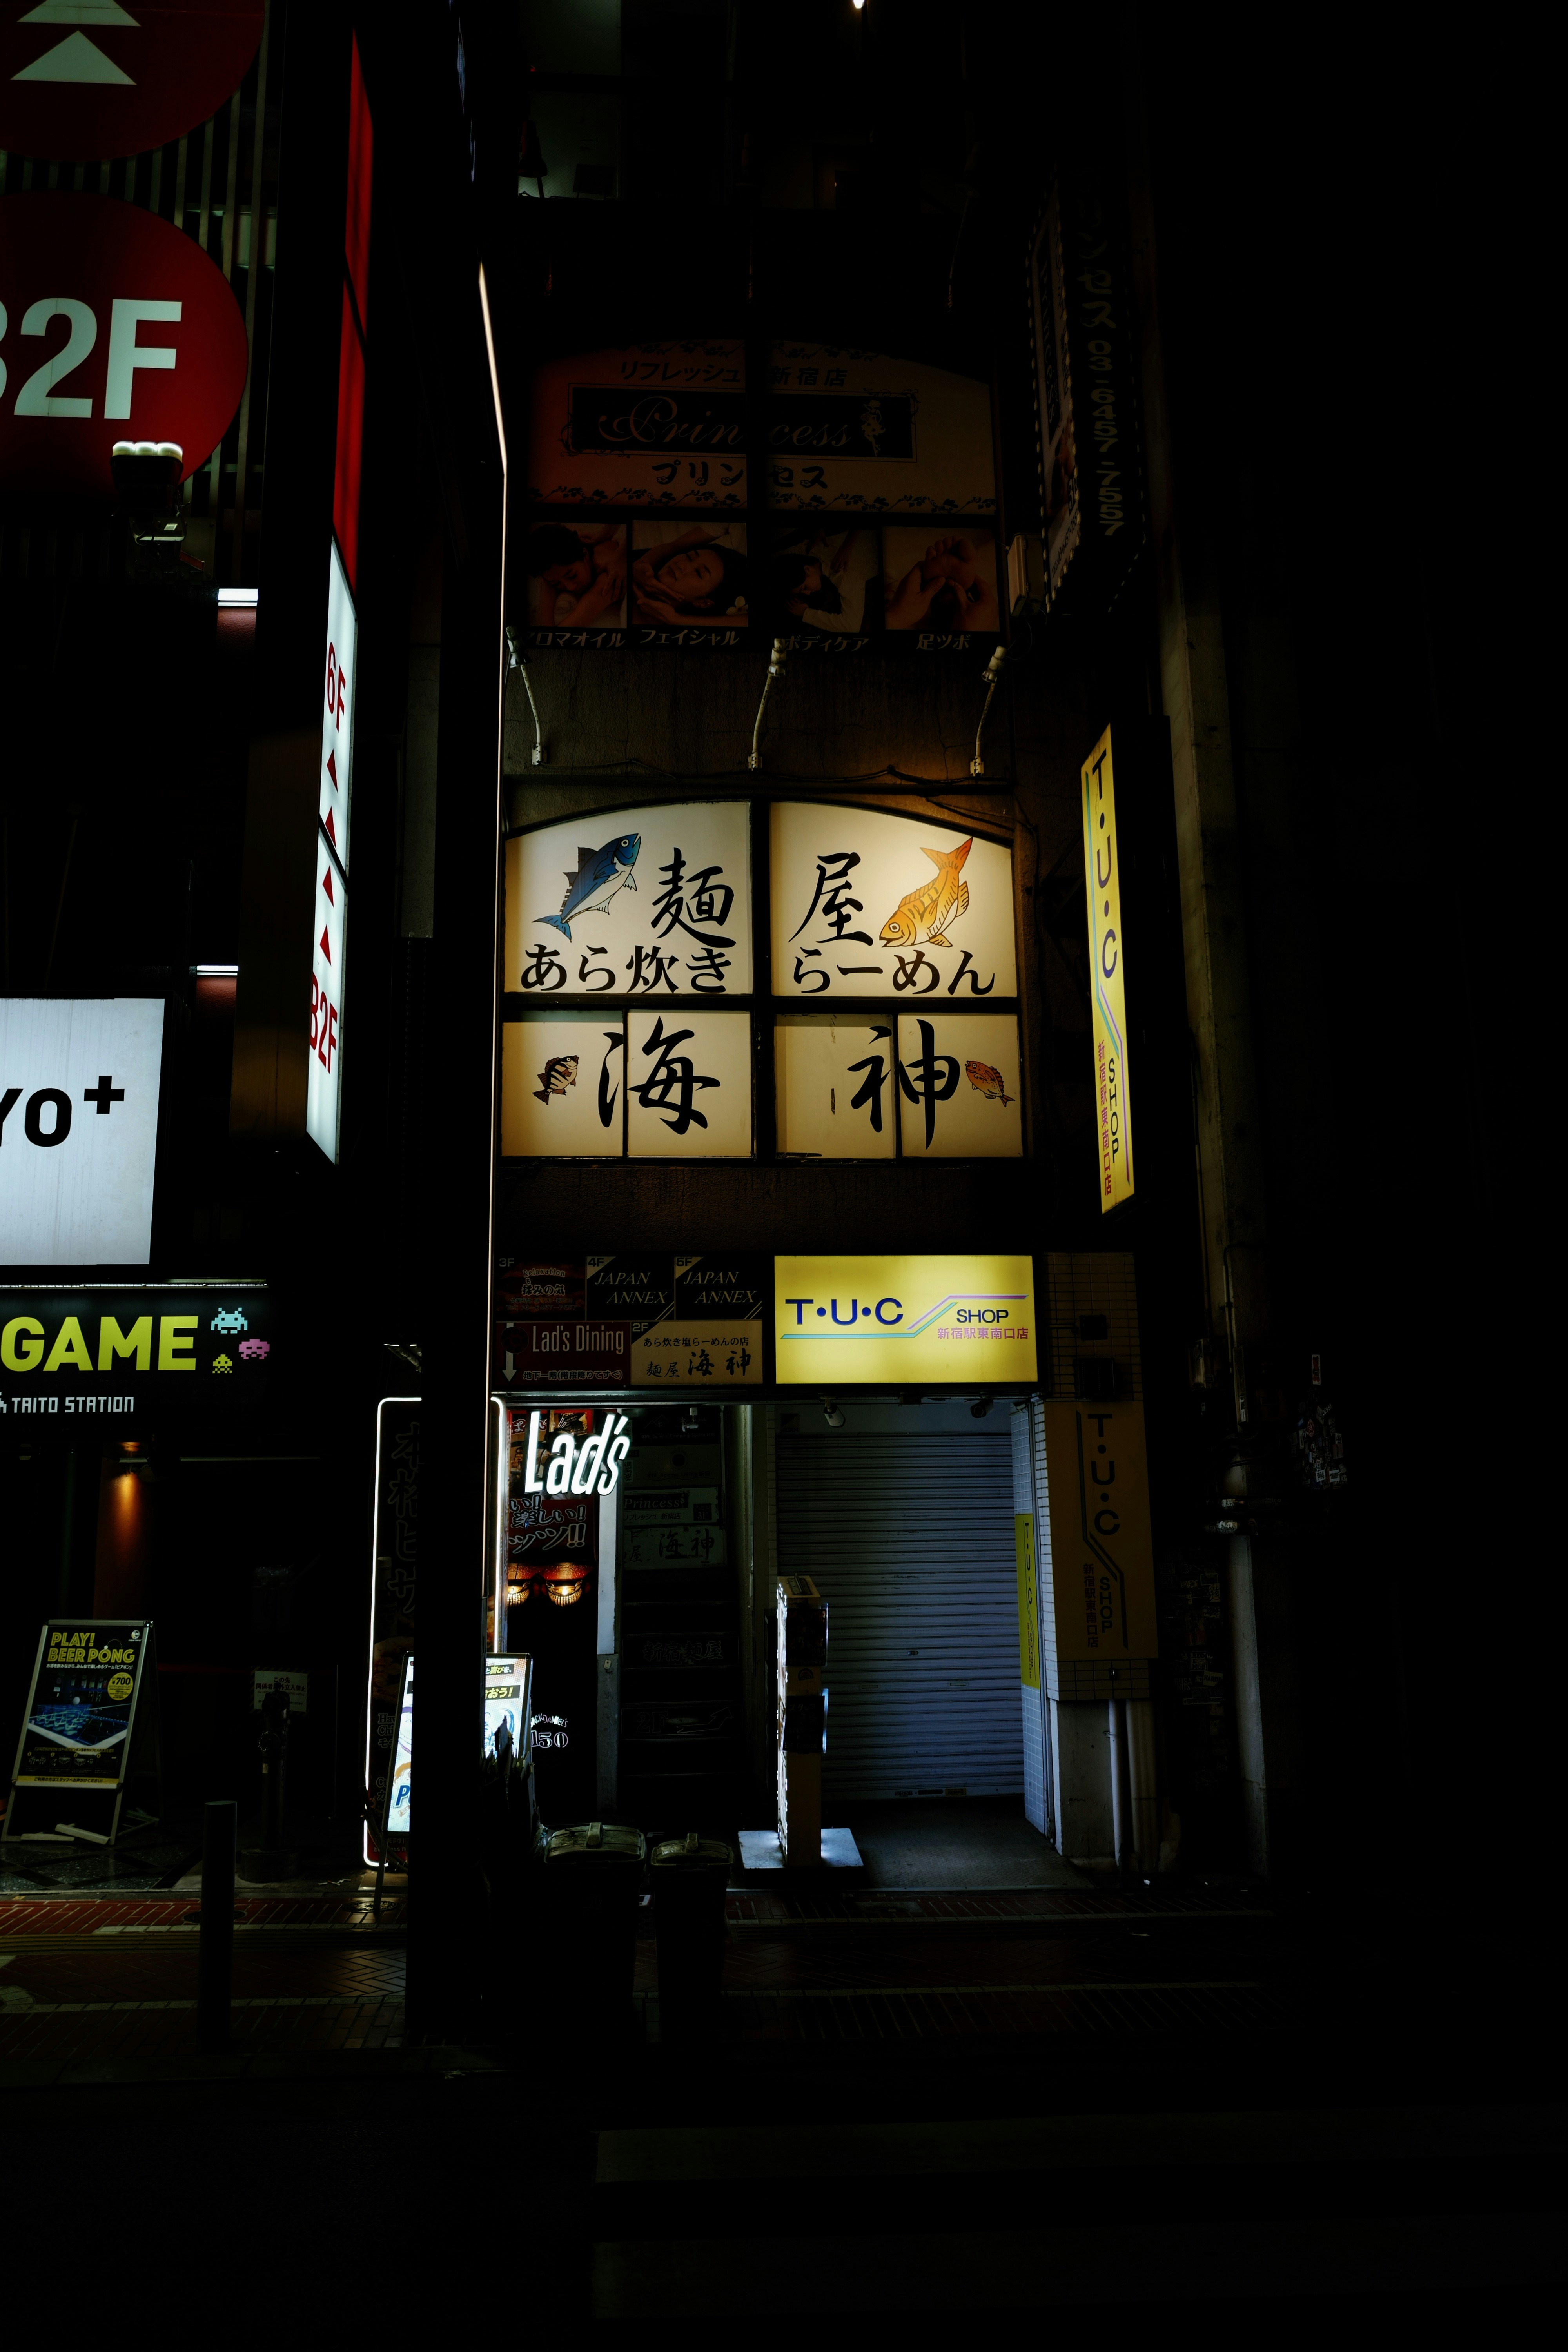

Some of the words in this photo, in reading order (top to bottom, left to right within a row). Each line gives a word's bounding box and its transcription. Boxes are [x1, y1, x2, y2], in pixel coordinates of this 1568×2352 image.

[0, 297, 182, 419] 2F
[621, 361, 740, 383] リフレッシュ
[768, 366, 848, 387] 新宿店
[598, 396, 854, 447] Princess
[652, 461, 828, 490] プリンセス
[639, 628, 740, 648] フェイシャル
[785, 635, 869, 652] ボディケア
[915, 633, 971, 651] 足ツボ
[326, 641, 346, 733] 6F
[521, 944, 732, 994] あら炊き
[793, 947, 995, 996] らーめん
[1107, 1058, 1120, 1164] SHOP
[498, 1258, 515, 1267] 3F
[588, 1258, 604, 1267] 4F
[676, 1257, 693, 1267] 5F
[522, 1267, 566, 1278] Relaxation
[594, 1272, 651, 1285] JAPAN
[683, 1271, 739, 1285] JAPAN
[522, 1283, 566, 1296] 揉みの気
[605, 1291, 669, 1304] ANNEX
[694, 1290, 757, 1304] ANNEX
[956, 1309, 1009, 1323] SHOP
[632, 1323, 649, 1332] 2F
[937, 1327, 1029, 1340] 新宿駅東南口店
[0, 1316, 199, 1372] GAME
[533, 1325, 570, 1353] Lad's
[575, 1325, 624, 1355] Dining
[643, 1337, 749, 1347] あら炊き塩らーめんの店
[11, 1397, 58, 1413] TAITO
[64, 1396, 134, 1413] STATION
[524, 1410, 631, 1496] Lad's
[624, 1498, 681, 1509] Princess
[1083, 1563, 1098, 1648] 新宿駅東南口店
[1099, 1577, 1113, 1633] SHOP
[51, 1632, 95, 1647] PLAY!
[47, 1648, 86, 1662] BEER
[87, 1648, 135, 1664] PONG
[256, 1682, 306, 1692] 関係者外立入禁止
